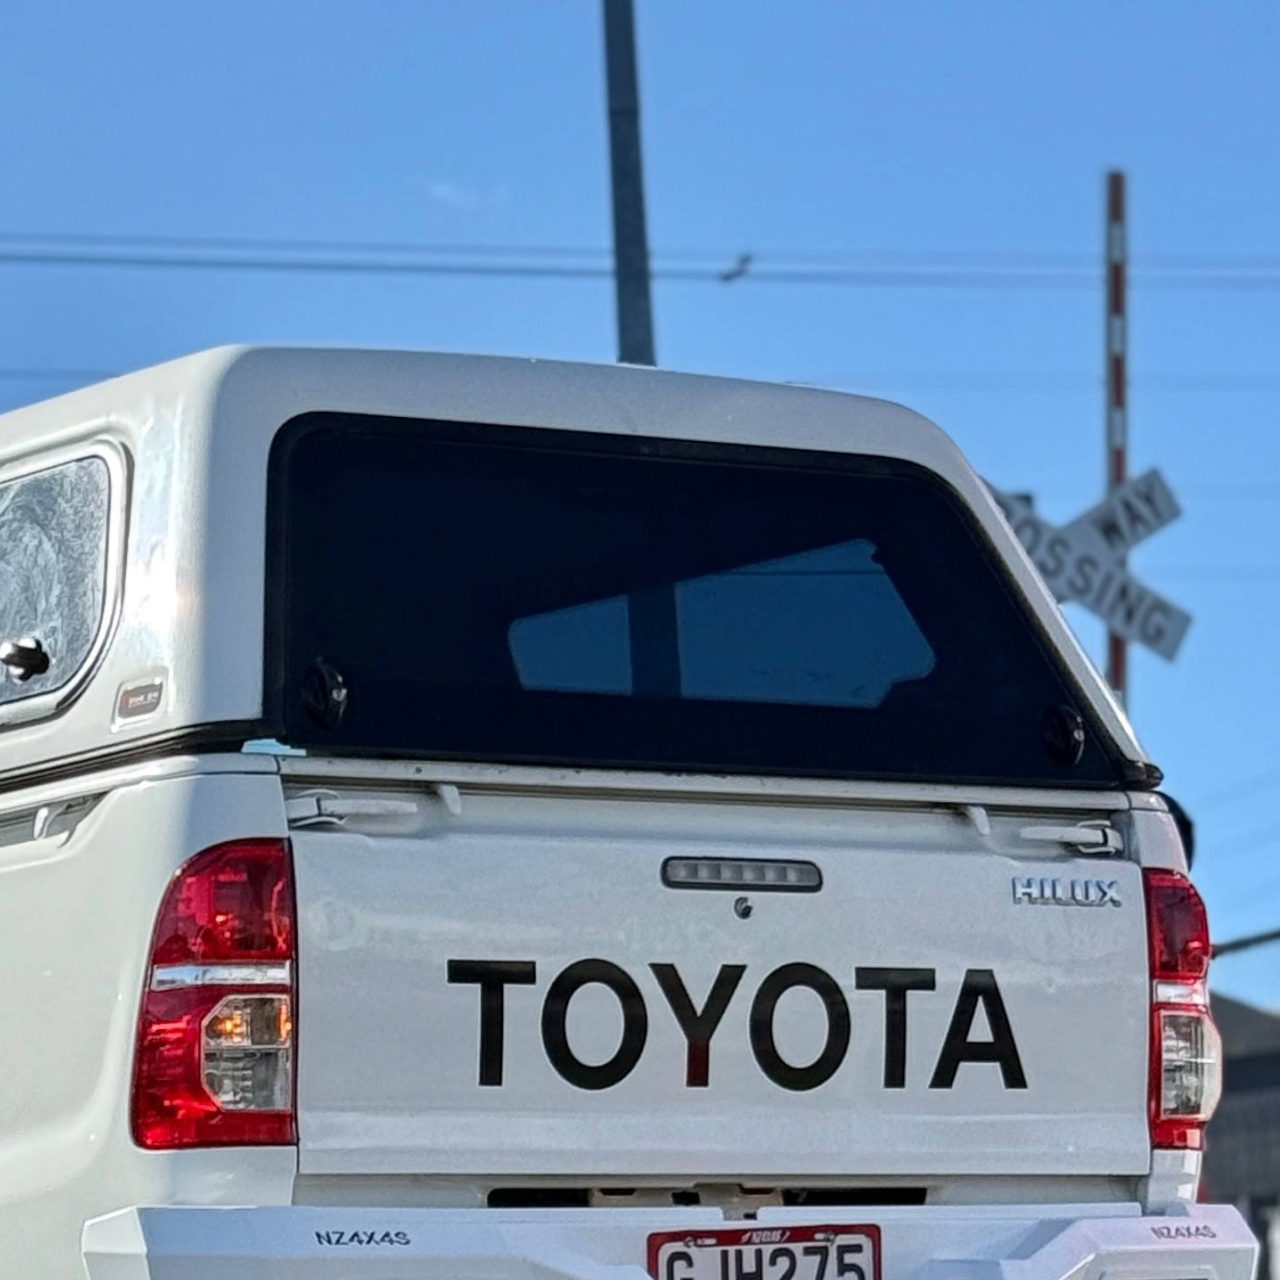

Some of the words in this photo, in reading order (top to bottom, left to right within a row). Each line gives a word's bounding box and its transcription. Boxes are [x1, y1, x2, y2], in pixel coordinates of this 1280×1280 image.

[1003, 502, 1169, 646] OSSING
[1011, 878, 1121, 907] HILUX
[447, 957, 1028, 1091] TOYOTA
[315, 1231, 410, 1246] NZ4X4S
